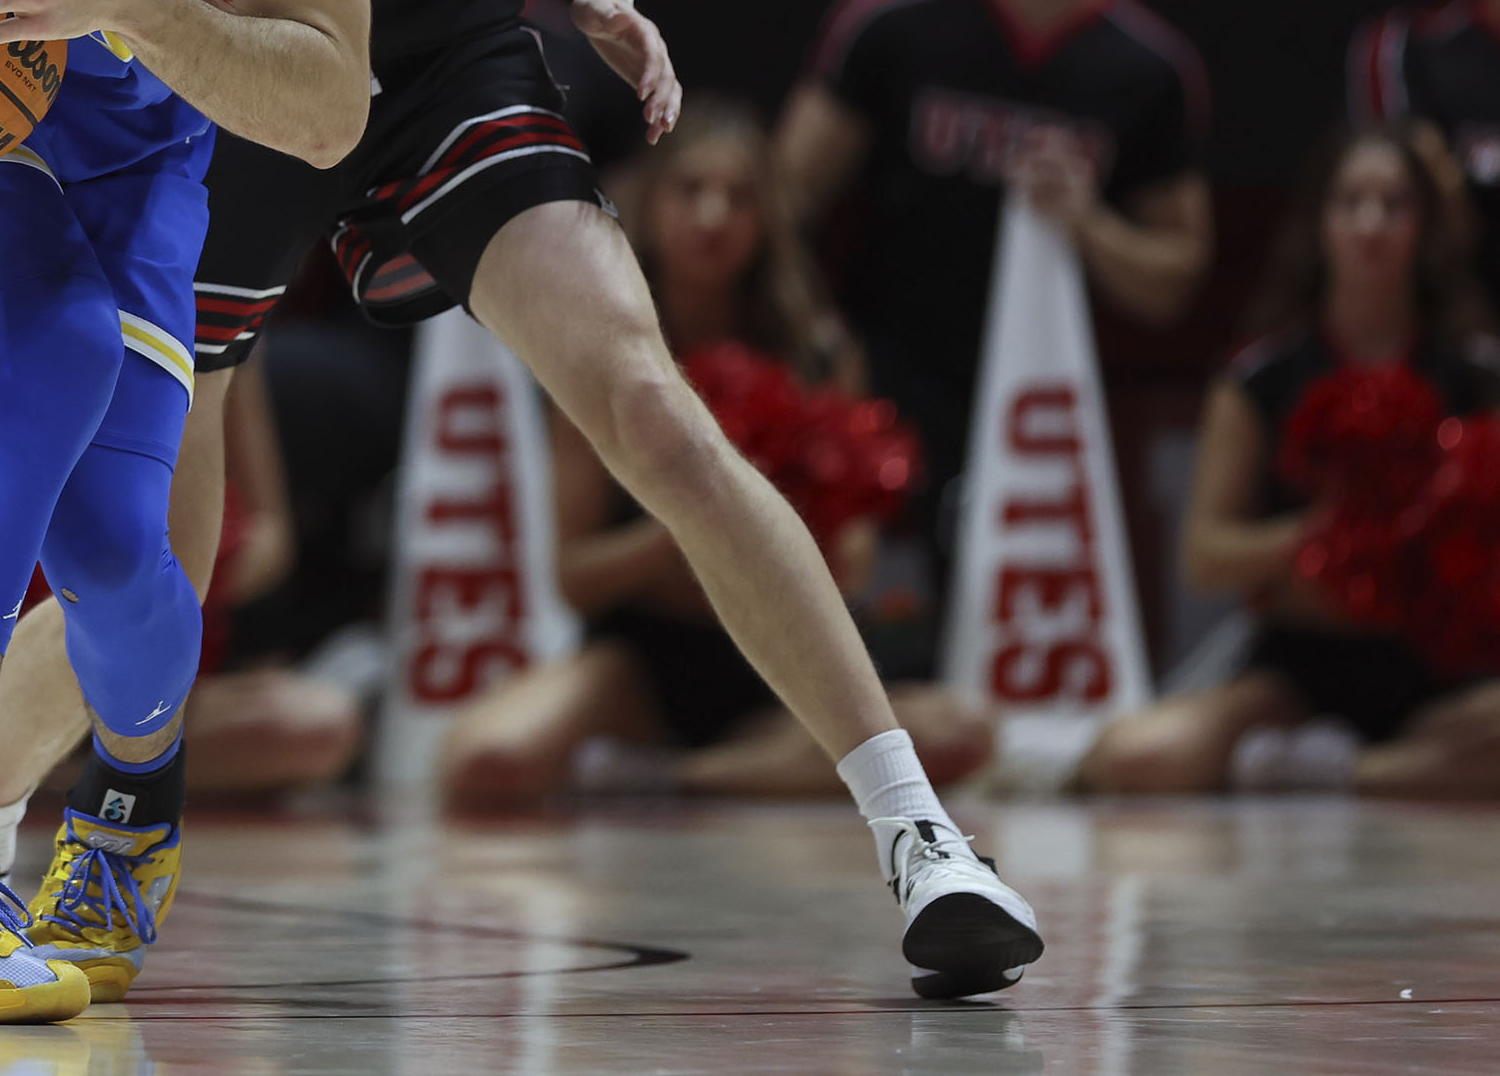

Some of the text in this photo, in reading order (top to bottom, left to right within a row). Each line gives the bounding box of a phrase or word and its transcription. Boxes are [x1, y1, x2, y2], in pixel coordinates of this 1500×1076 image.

[4, 59, 38, 93] EVO NXT
[409, 380, 532, 705] UTES
[987, 384, 1121, 707] UTES
